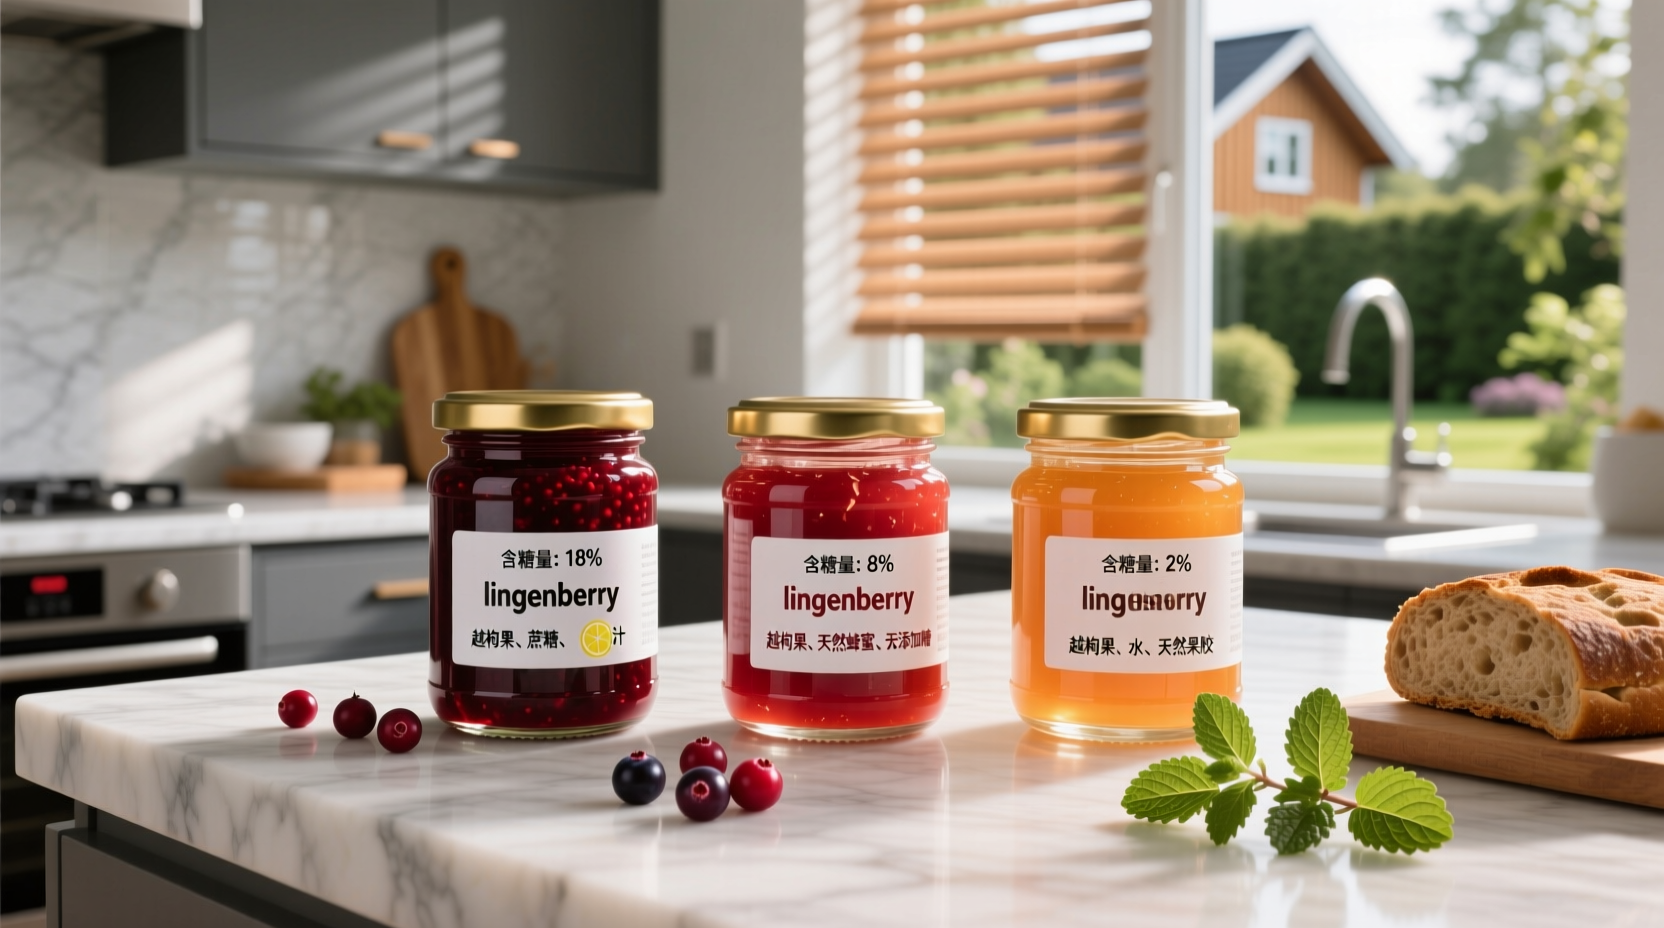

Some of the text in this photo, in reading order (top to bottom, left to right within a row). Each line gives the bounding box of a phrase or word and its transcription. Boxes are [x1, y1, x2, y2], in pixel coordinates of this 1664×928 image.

[565, 547, 603, 568] 18%
[866, 554, 894, 573] 8%
[1165, 553, 1192, 572] 2%
[484, 581, 619, 614] lingenberry
[783, 585, 915, 617] lingenberry
